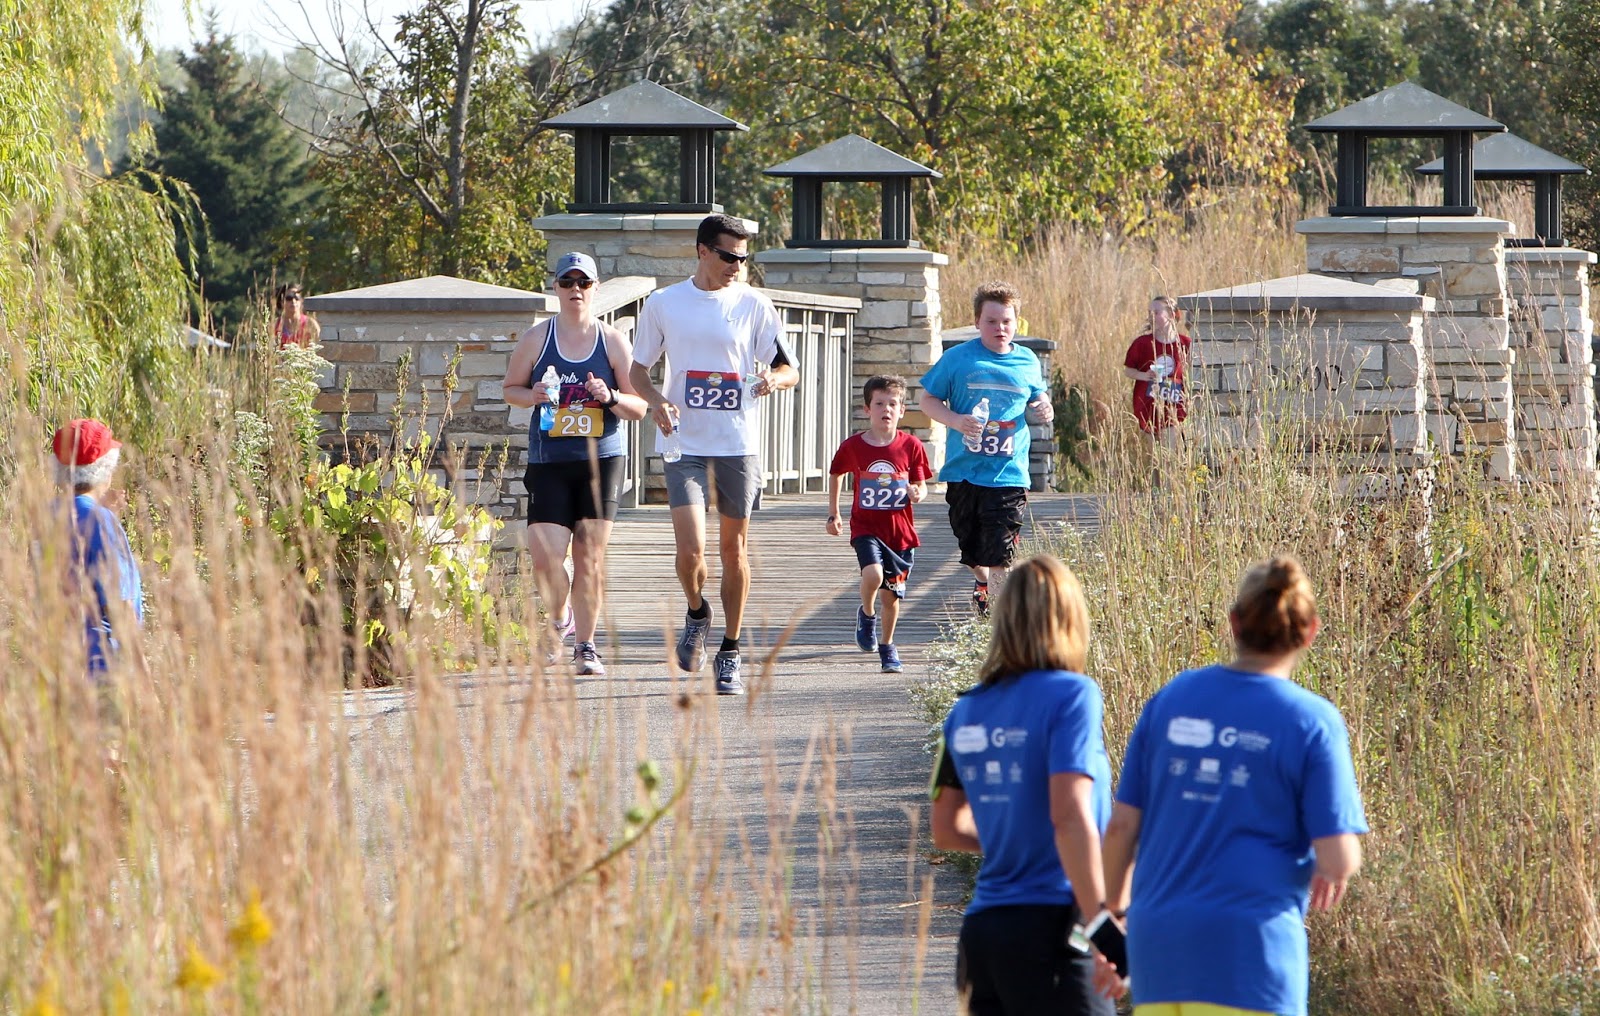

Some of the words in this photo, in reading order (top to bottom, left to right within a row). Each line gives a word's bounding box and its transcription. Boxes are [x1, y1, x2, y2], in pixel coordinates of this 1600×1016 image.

[688, 386, 739, 409] 323
[561, 414, 592, 435] 29
[861, 487, 907, 508] 322
